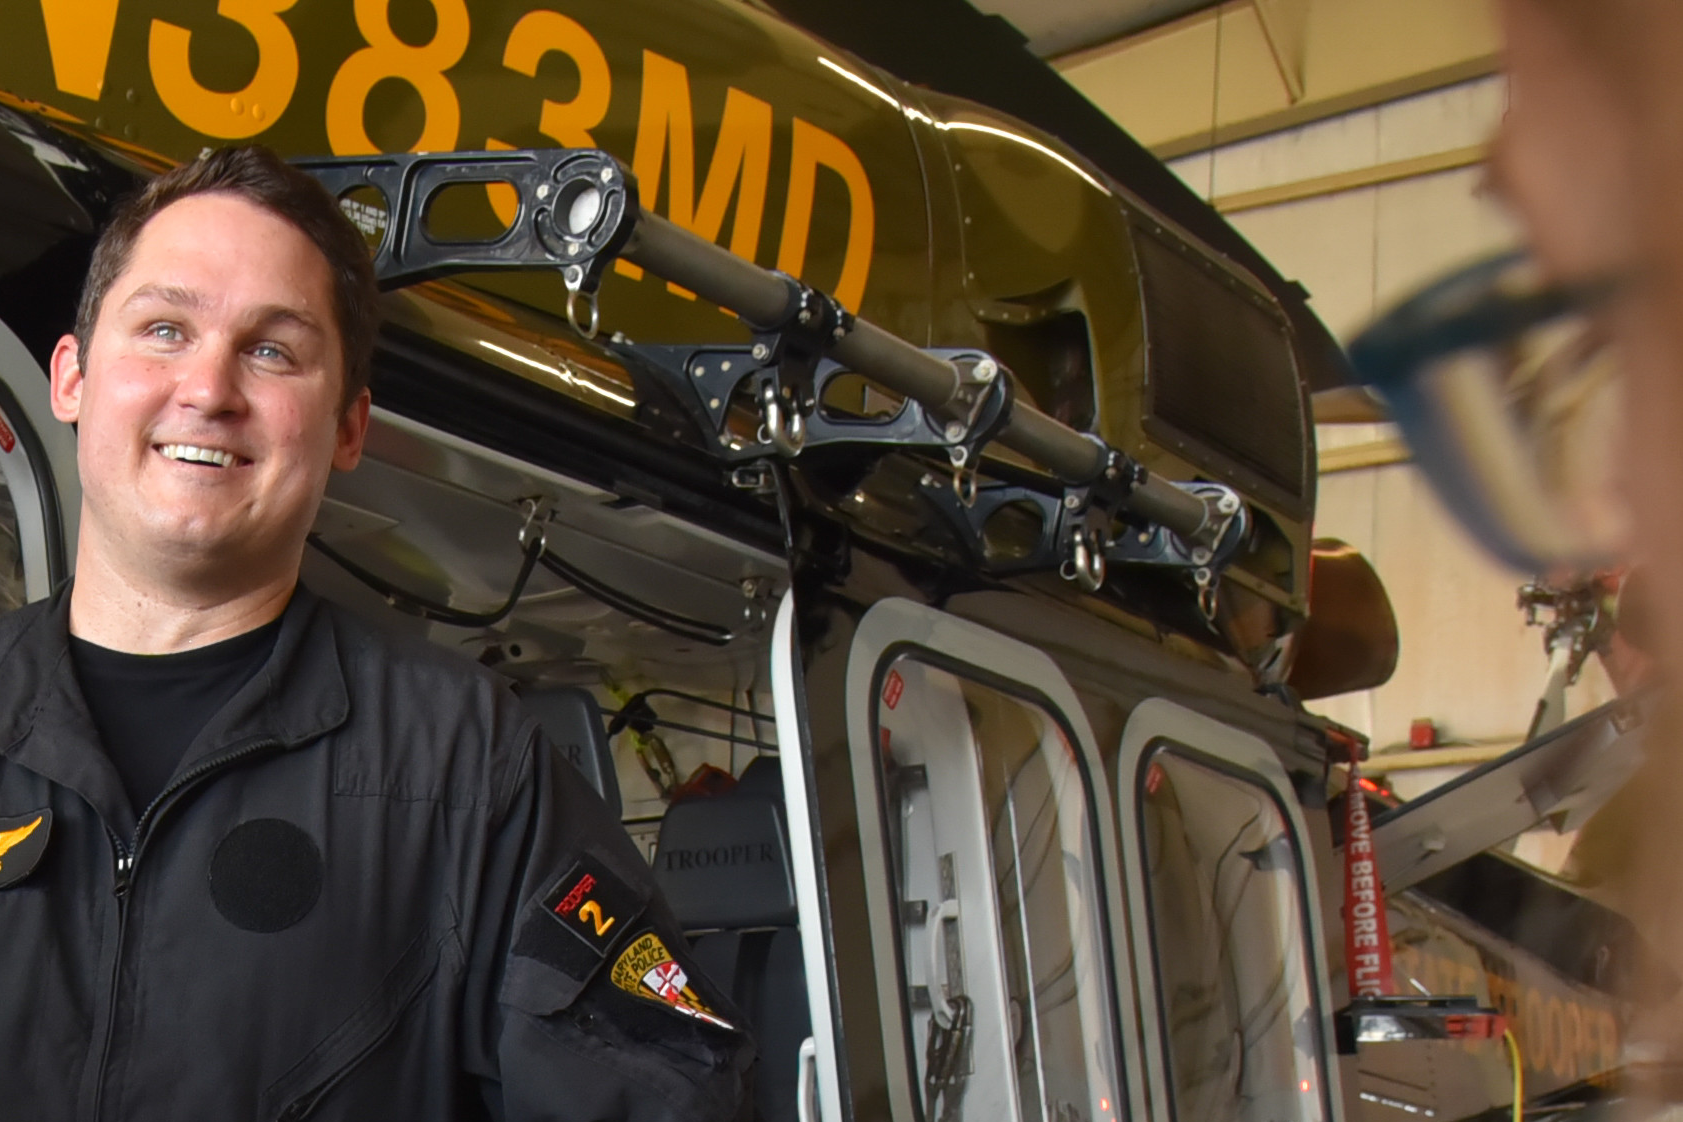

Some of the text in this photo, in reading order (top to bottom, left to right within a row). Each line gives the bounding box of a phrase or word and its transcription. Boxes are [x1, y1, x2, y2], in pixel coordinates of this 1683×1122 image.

[664, 843, 775, 872] TROOPER
[578, 900, 615, 936] 2
[1351, 860, 1379, 949] BEFORE
[613, 937, 653, 986] MARYLAND
[632, 946, 665, 974] POLICE
